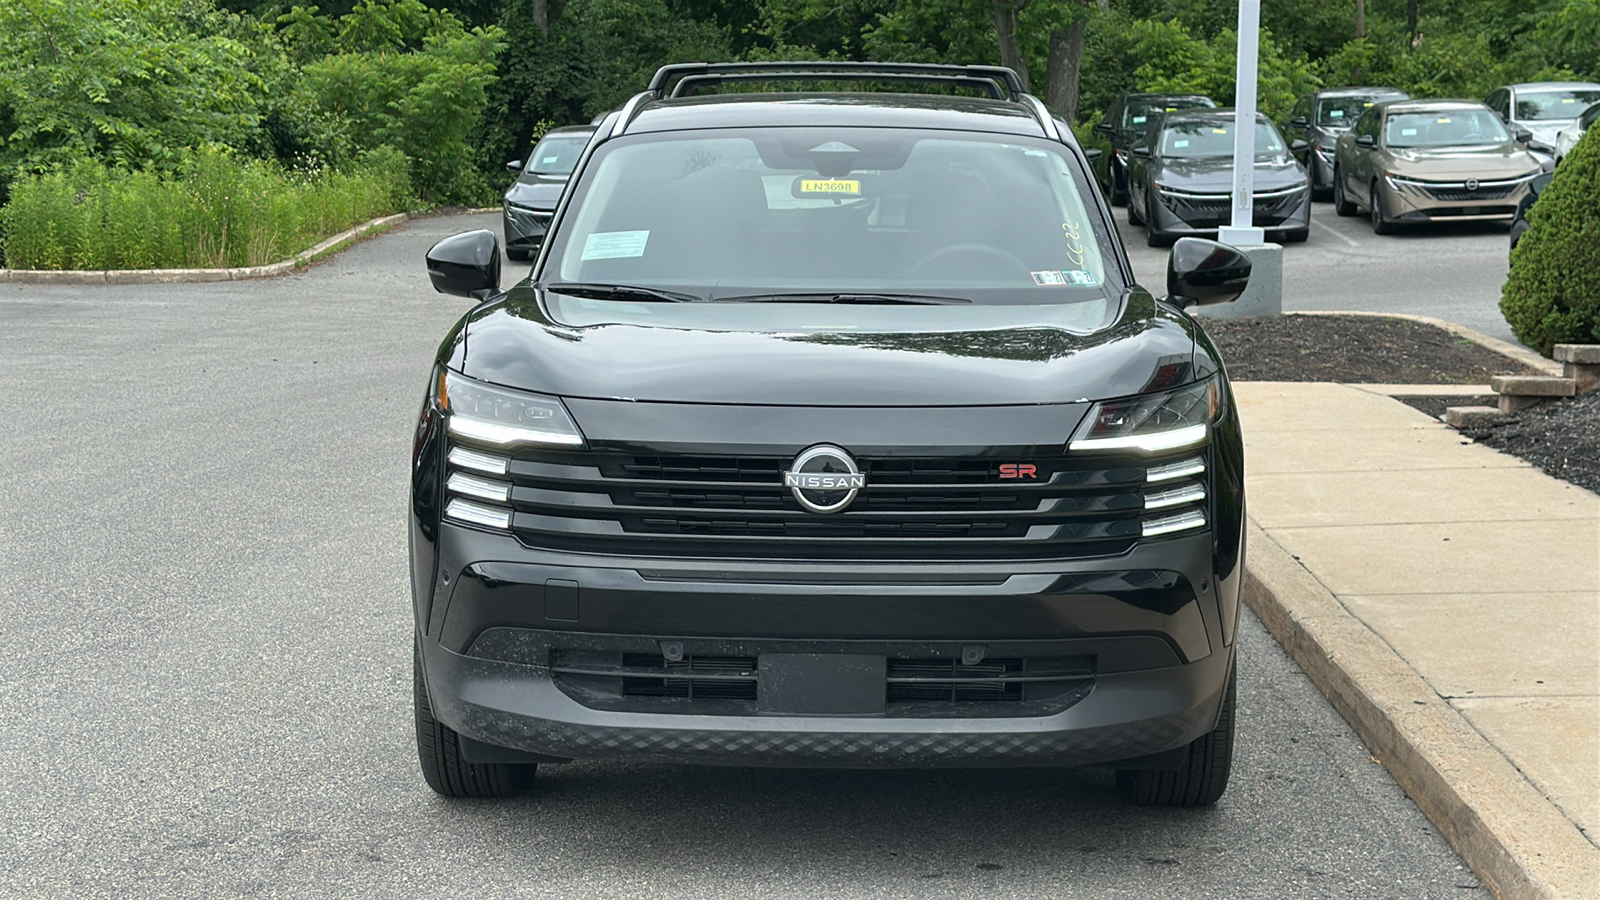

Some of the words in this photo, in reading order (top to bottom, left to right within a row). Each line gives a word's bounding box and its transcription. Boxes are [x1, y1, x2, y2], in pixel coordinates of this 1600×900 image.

[806, 182, 852, 191] LN3698
[999, 464, 1037, 478] SR
[787, 475, 863, 488] NISSAN
